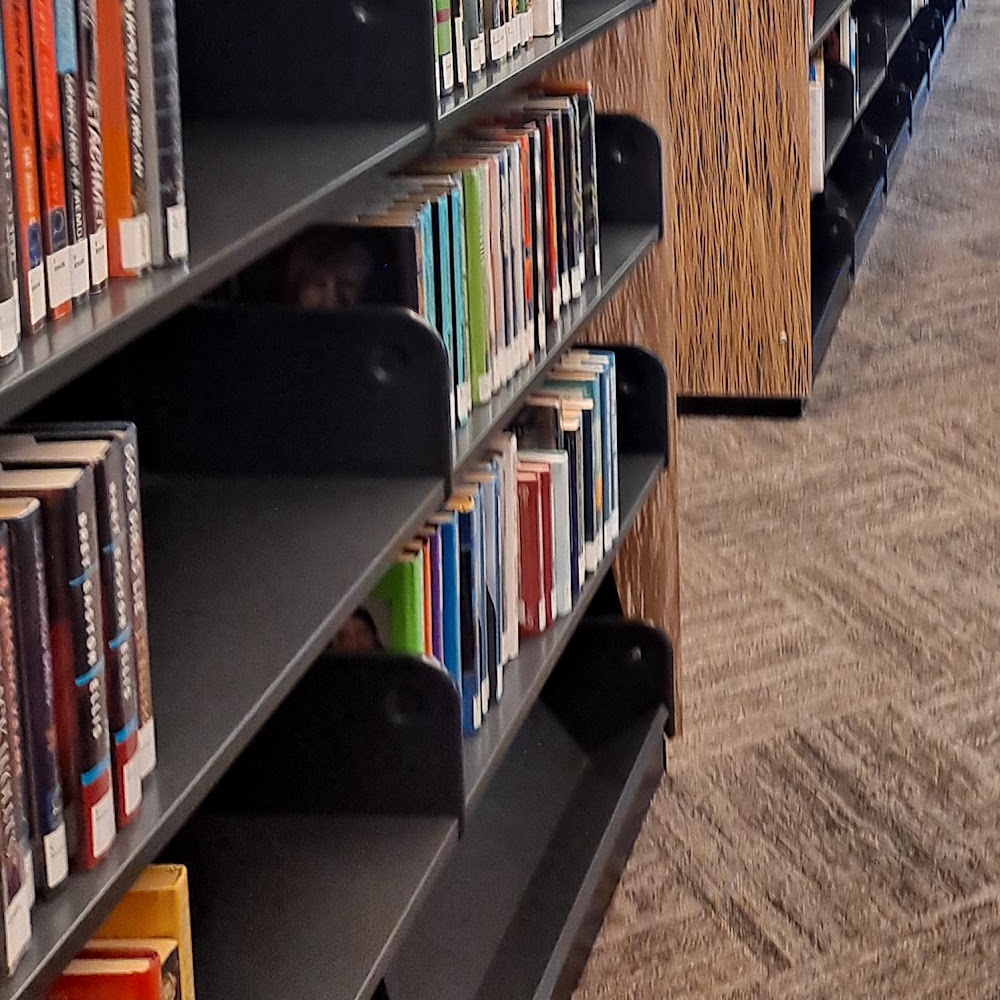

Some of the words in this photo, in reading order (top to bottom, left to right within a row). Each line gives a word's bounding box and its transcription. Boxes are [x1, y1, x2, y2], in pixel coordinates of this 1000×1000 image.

[84, 80, 106, 232] DETACHMEN
[122, 441, 138, 504] GOOD
[127, 507, 142, 574] GIRLS
